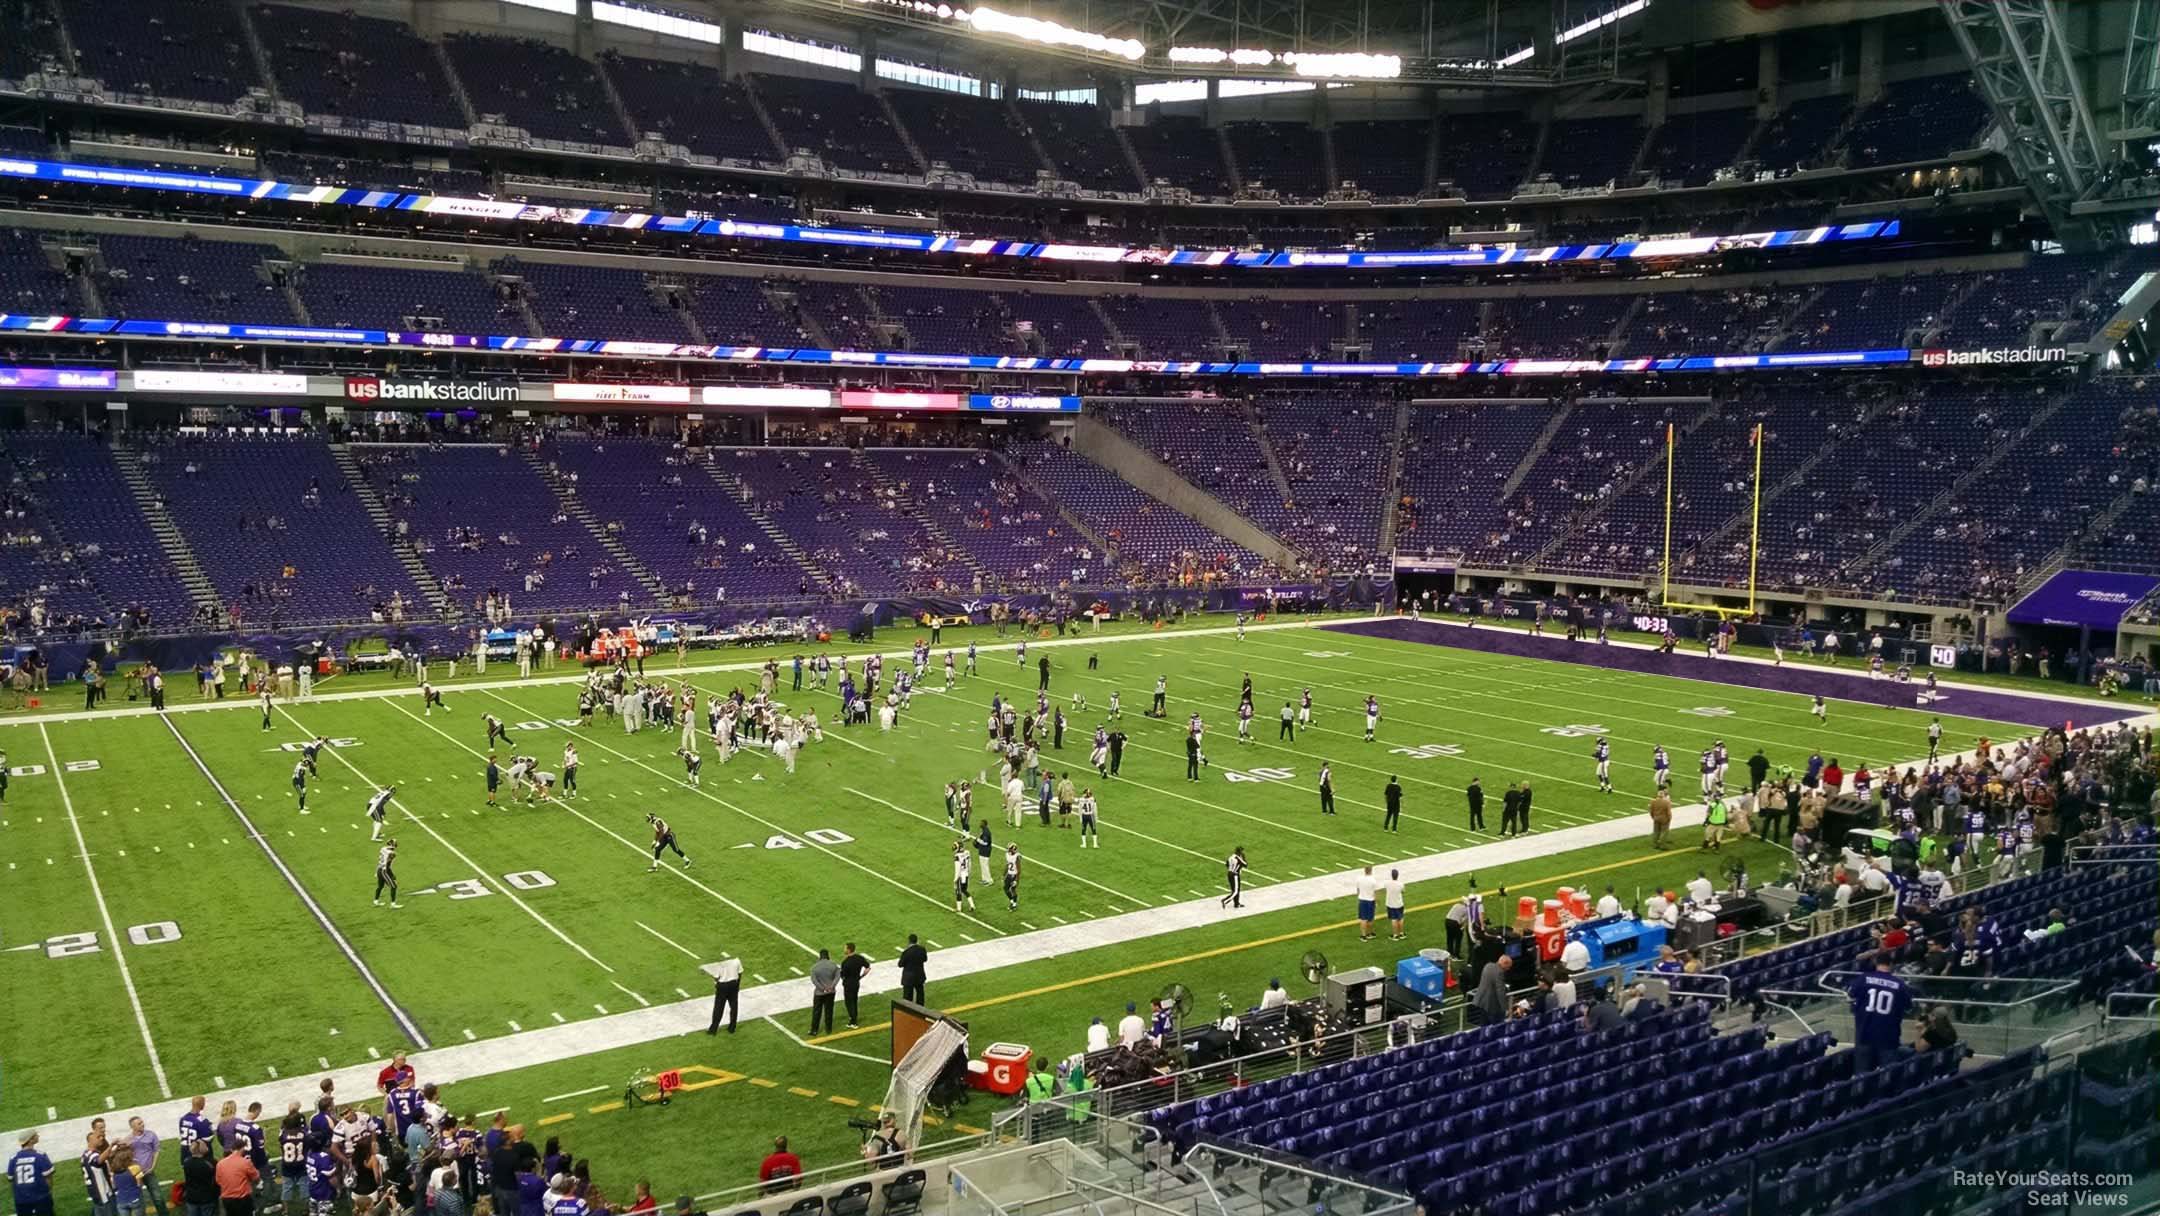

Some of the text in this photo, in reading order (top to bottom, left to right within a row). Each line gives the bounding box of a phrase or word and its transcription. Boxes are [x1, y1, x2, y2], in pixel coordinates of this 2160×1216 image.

[323, 127, 388, 140] MINNESOTA VIKINGS
[406, 135, 453, 147] RING OF HONOR
[1633, 616, 1668, 633] 40:33
[1933, 649, 1954, 665] 40
[1224, 767, 1297, 783] 40
[1865, 988, 1894, 1015] 10
[663, 1072, 679, 1089] 30
[993, 1065, 1010, 1084] G
[399, 1099, 411, 1116] 3
[283, 1142, 304, 1163] 81
[15, 1164, 35, 1184] 12
